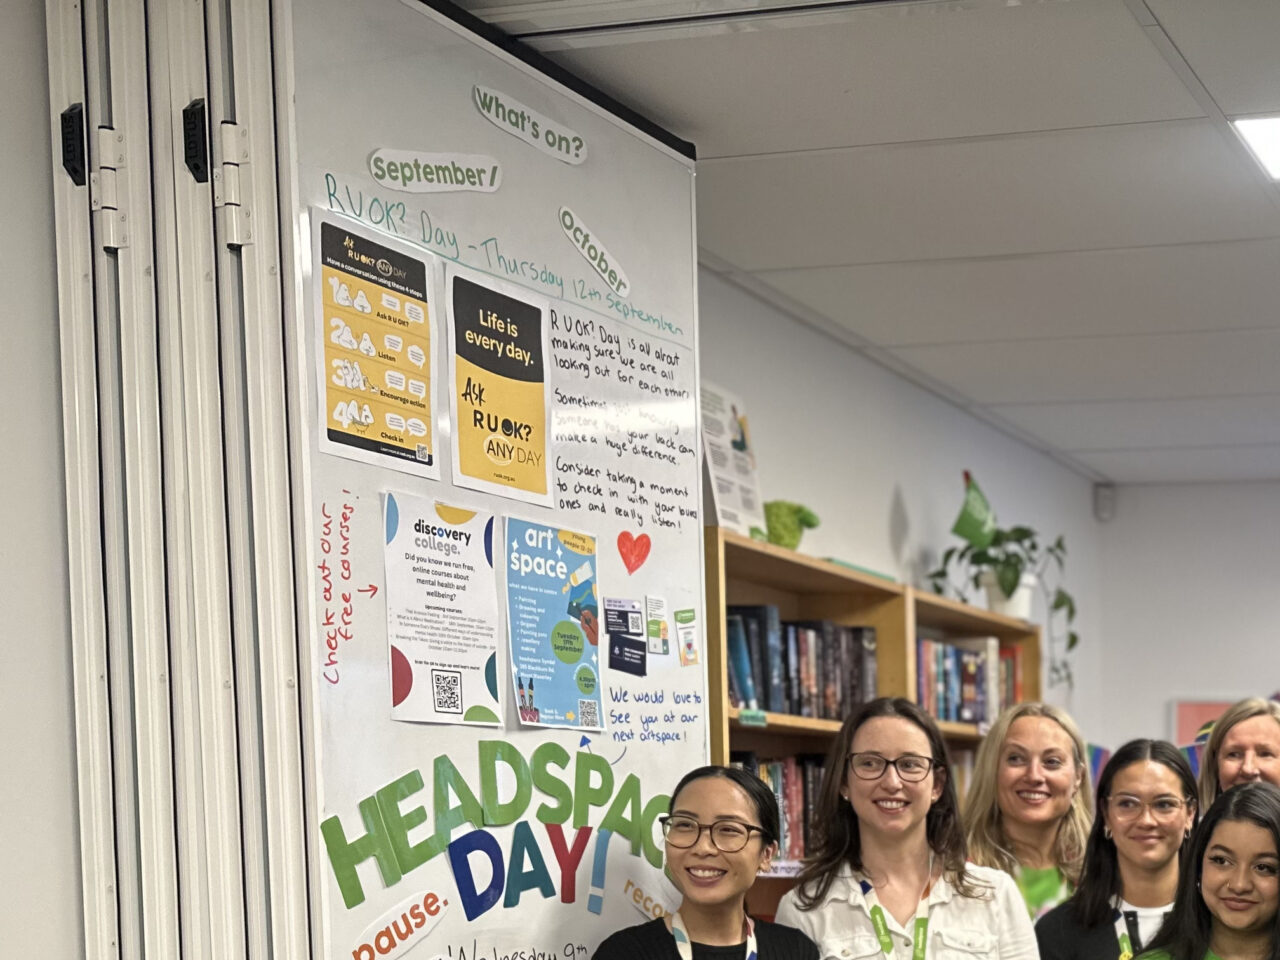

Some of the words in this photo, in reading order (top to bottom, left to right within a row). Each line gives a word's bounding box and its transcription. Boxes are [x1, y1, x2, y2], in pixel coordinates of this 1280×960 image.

[474, 86, 540, 139] What's
[545, 130, 584, 158] on?
[373, 156, 485, 187] September
[325, 173, 345, 212] R
[345, 185, 363, 217] U
[369, 197, 406, 234] OK?
[420, 210, 460, 260] Day
[480, 237, 564, 298] Thursday
[573, 279, 602, 301] 12th
[606, 294, 683, 335] September
[561, 210, 627, 293] October
[479, 308, 504, 333] Life
[507, 318, 518, 337] is
[550, 309, 559, 331] R
[564, 314, 572, 333] U
[575, 320, 595, 340] OK?
[599, 326, 621, 355] Day
[628, 338, 636, 350] is
[640, 343, 651, 357] all
[378, 352, 396, 362] Listen
[465, 330, 503, 357] every
[506, 341, 534, 365] day.
[551, 337, 591, 361] making
[594, 346, 615, 360] sure
[620, 355, 635, 369] we
[640, 363, 657, 375] are
[661, 370, 674, 381] all
[554, 354, 590, 378] looking
[595, 366, 610, 376] out
[618, 371, 634, 384] for
[639, 380, 661, 394] each
[380, 390, 409, 404] Encourage
[462, 377, 486, 408] Ask
[381, 432, 398, 442] Check
[474, 410, 484, 430] R
[487, 413, 498, 433] U
[501, 418, 532, 442] OK?
[487, 440, 514, 460] ANY
[517, 447, 542, 467] DAY
[606, 437, 628, 457] huge
[627, 431, 649, 446] your
[679, 444, 696, 459] can
[556, 456, 600, 477] Consider
[607, 469, 637, 494] taking
[650, 483, 688, 498] moment
[557, 478, 568, 492] to
[574, 482, 603, 496] check
[609, 488, 618, 498] in
[628, 495, 648, 505] with
[655, 501, 675, 516] your
[560, 499, 581, 509] ones
[589, 503, 606, 513] and
[615, 507, 643, 527] really
[320, 502, 332, 554] our
[414, 519, 471, 546] discovery
[525, 528, 553, 550] art
[415, 536, 460, 556] college.
[413, 566, 430, 574] online
[431, 569, 452, 578] courses
[454, 572, 469, 581] about
[428, 557, 442, 565] know
[511, 552, 567, 580] space
[318, 559, 332, 601] out
[417, 578, 436, 586] mental
[437, 581, 455, 589] health
[426, 590, 456, 601] wellbeing?
[338, 592, 353, 640] free
[323, 608, 339, 685] Check
[610, 688, 628, 703] We
[633, 690, 664, 704] would
[673, 692, 691, 704] love
[641, 715, 658, 732] you
[664, 711, 675, 722] at
[681, 714, 698, 722] our
[613, 731, 634, 742] next
[320, 740, 674, 910] HEADSPAC
[448, 820, 613, 922] DAY!
